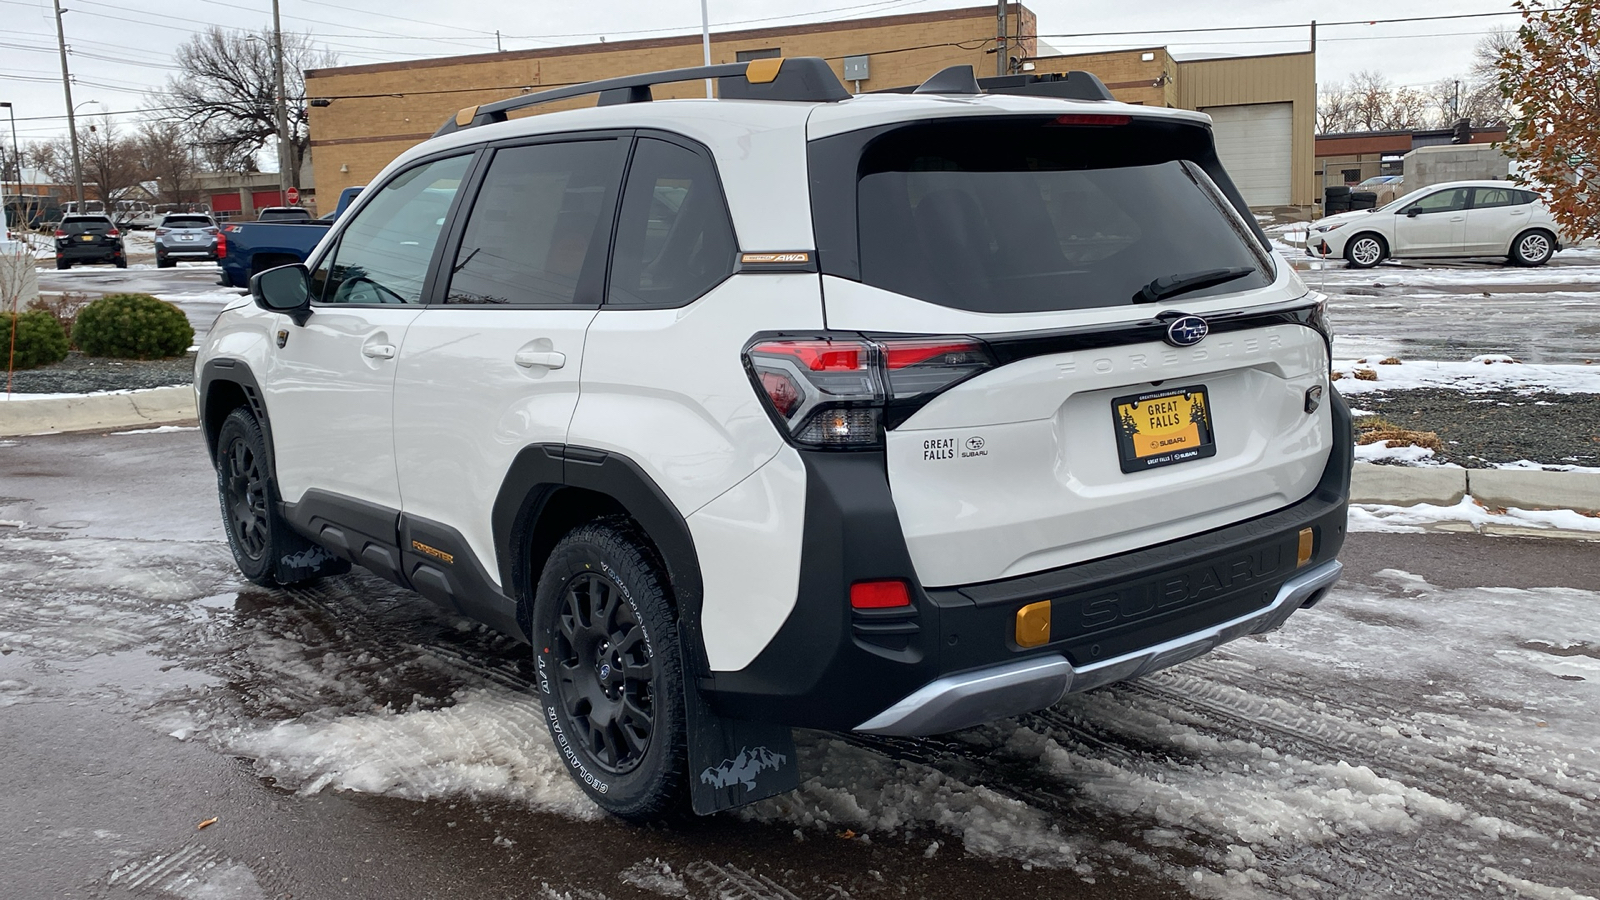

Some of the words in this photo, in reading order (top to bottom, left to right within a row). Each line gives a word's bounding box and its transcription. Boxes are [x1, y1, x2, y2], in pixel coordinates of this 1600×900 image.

[1056, 334, 1283, 379] FORESTER
[1147, 400, 1178, 416] GREAT
[1149, 413, 1180, 429] FALLS
[923, 438, 954, 450] GREAT
[1159, 436, 1186, 447] SUBARU
[923, 448, 954, 461] FALLS
[961, 450, 988, 458] SUBARU
[1180, 450, 1198, 458] SUBARU
[412, 540, 454, 564] FORESTER
[1081, 544, 1281, 628] SUBARU
[547, 706, 609, 794] GEOLANDAR
